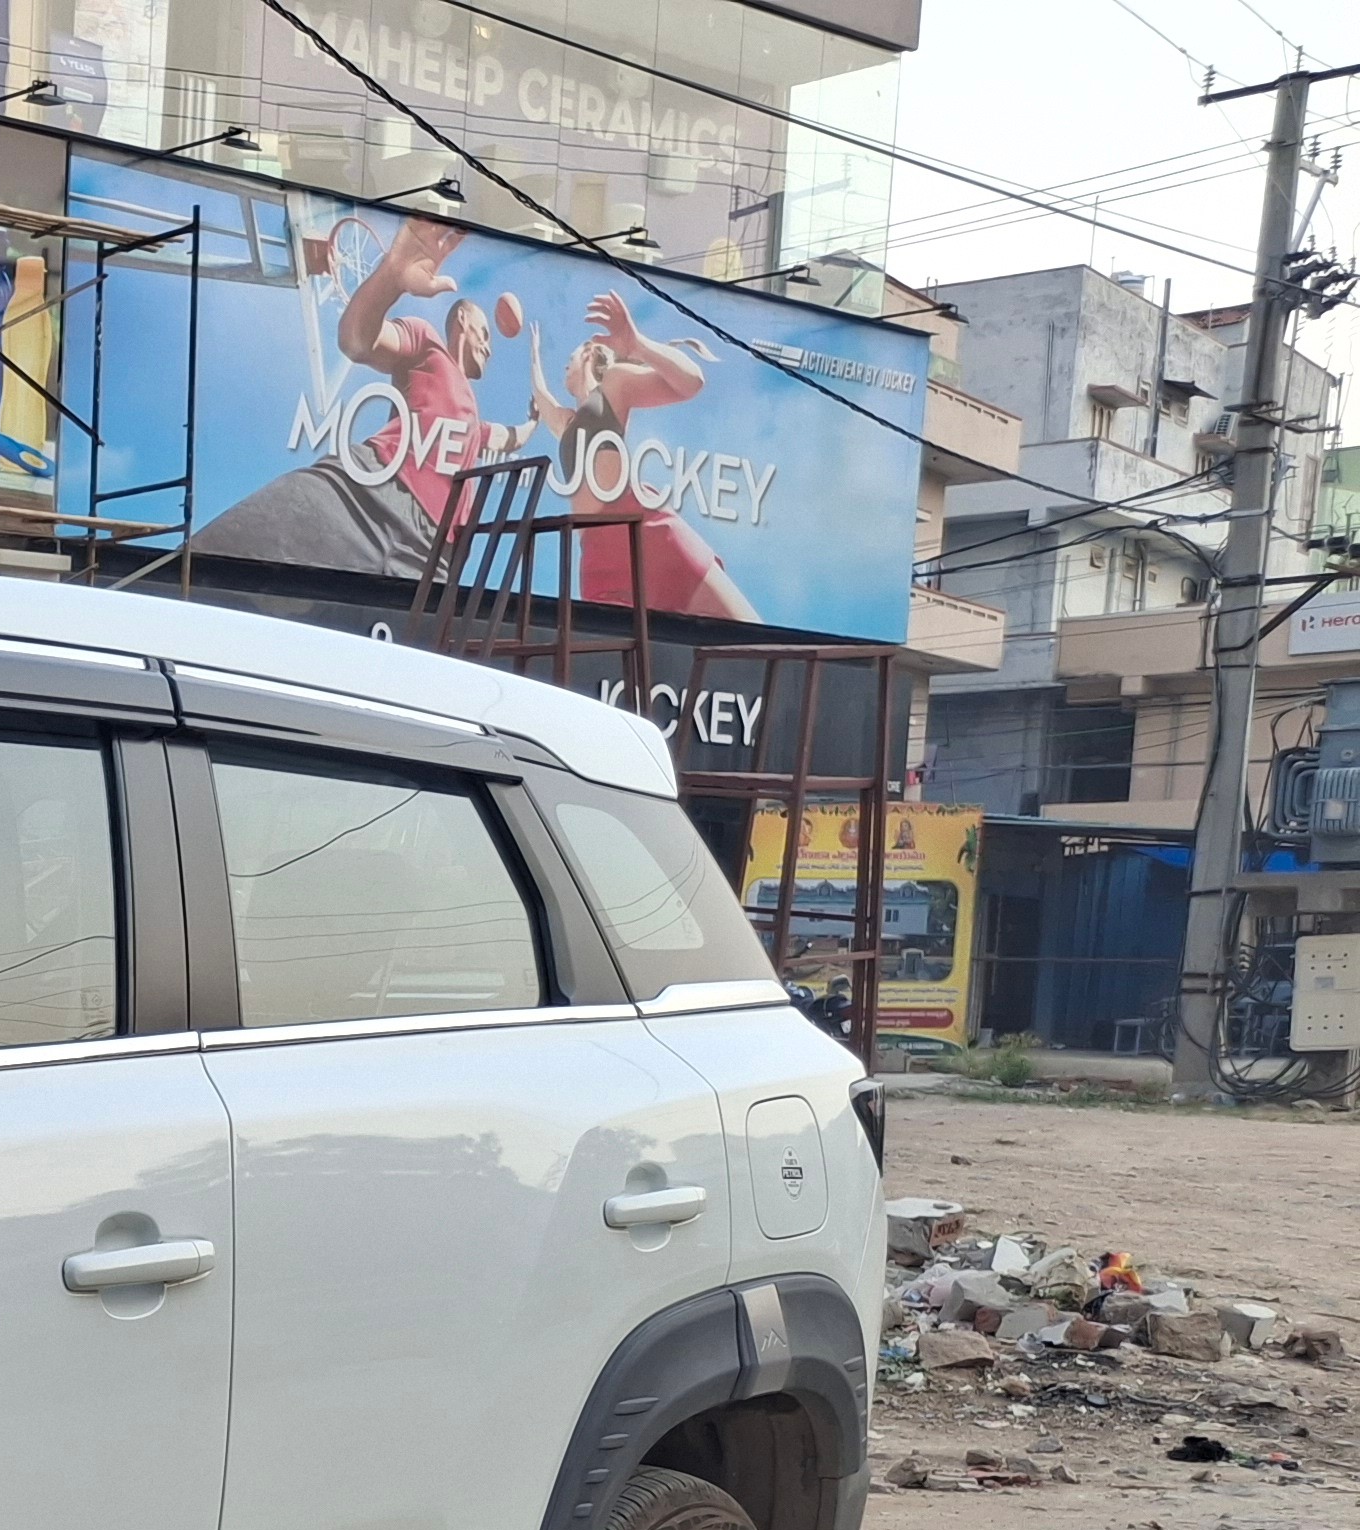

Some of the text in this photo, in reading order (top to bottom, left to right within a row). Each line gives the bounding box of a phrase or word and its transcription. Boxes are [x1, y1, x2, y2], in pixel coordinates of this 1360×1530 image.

[292, 8, 741, 175] MAHEEP CERAMICS
[800, 350, 916, 394] ACTIVEWEAR BY JOCKEY
[287, 383, 468, 487] MOVE
[547, 428, 777, 525] JOCKEY
